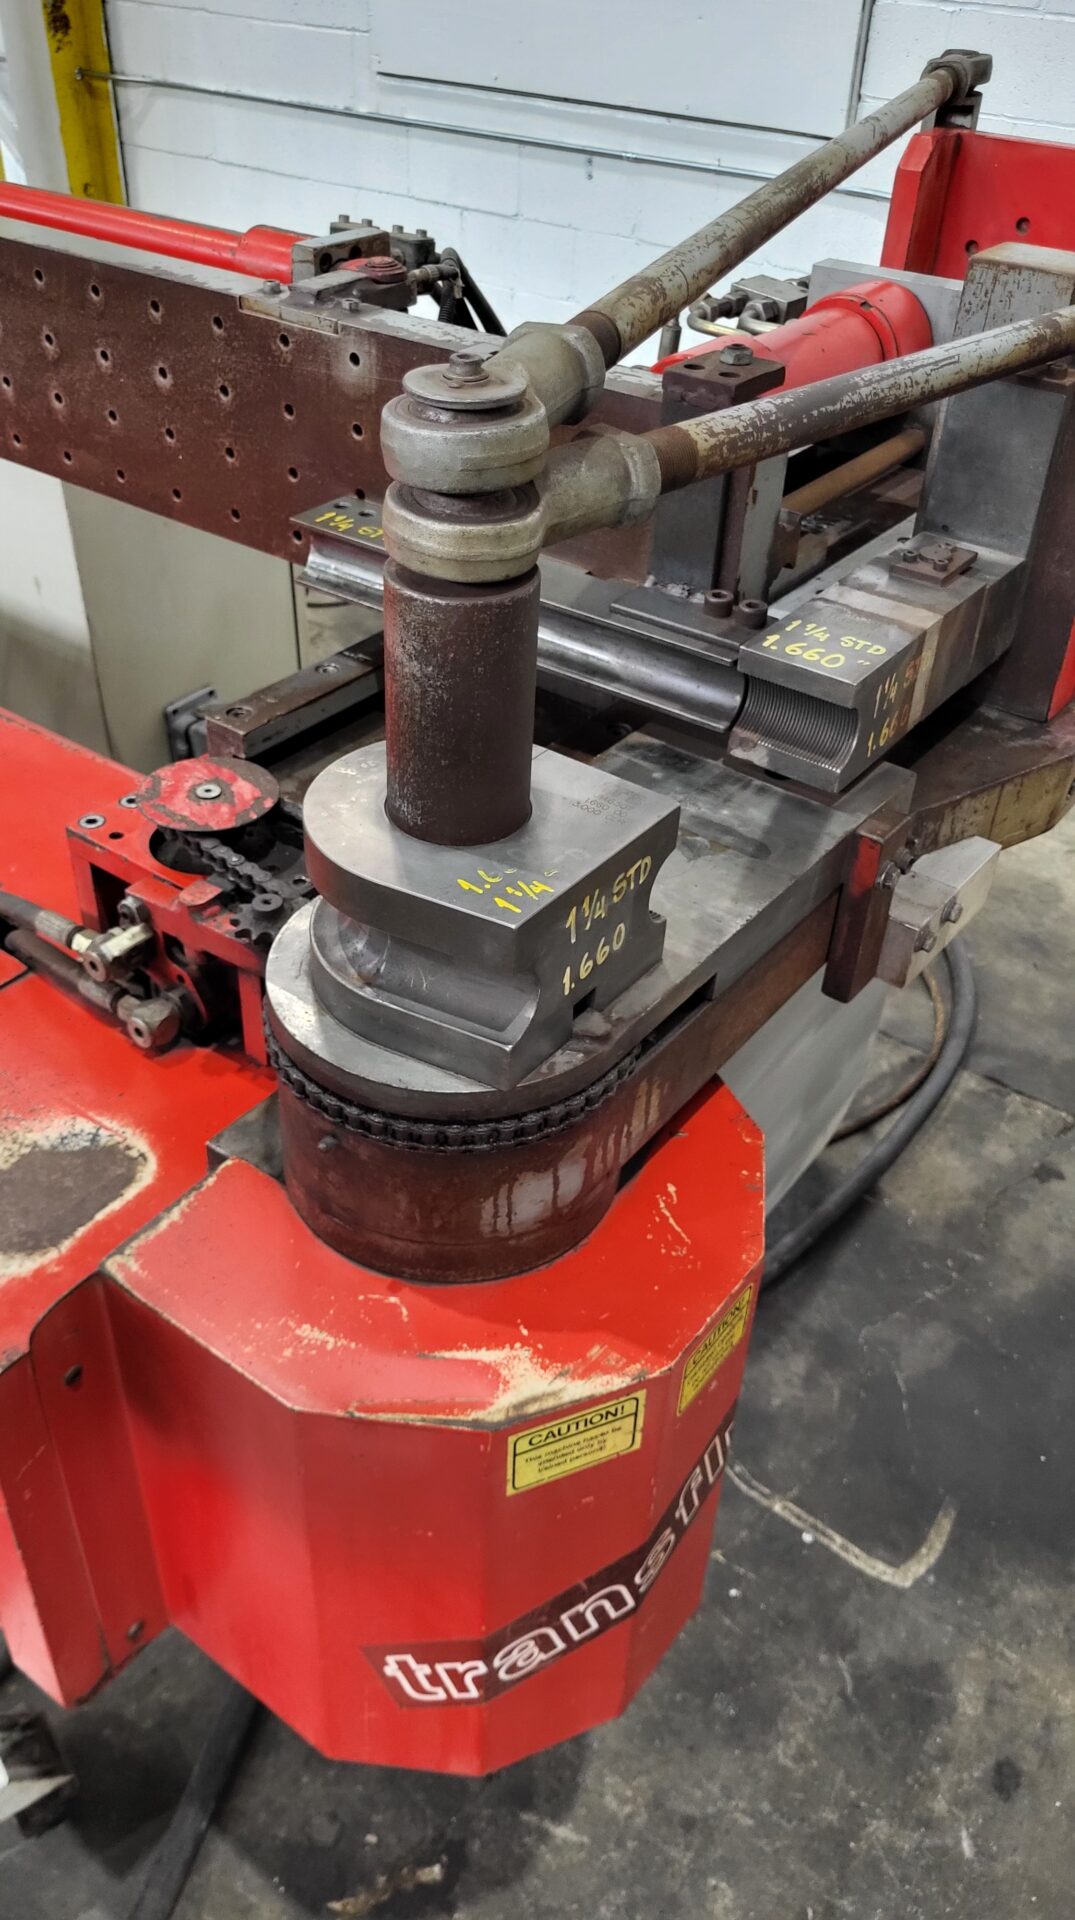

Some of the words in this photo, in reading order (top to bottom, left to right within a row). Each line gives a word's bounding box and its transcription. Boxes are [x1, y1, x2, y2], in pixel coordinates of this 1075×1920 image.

[762, 633, 846, 669] 1.660
[784, 619, 802, 632] 1
[803, 623, 831, 642] 1/4
[840, 635, 887, 656] STD
[867, 703, 910, 758] 1.660
[565, 906, 577, 944] 1
[581, 888, 607, 931] 1/4
[612, 855, 653, 904] STD
[562, 922, 626, 996] 1.660
[527, 1404, 626, 1447] CAUTION!
